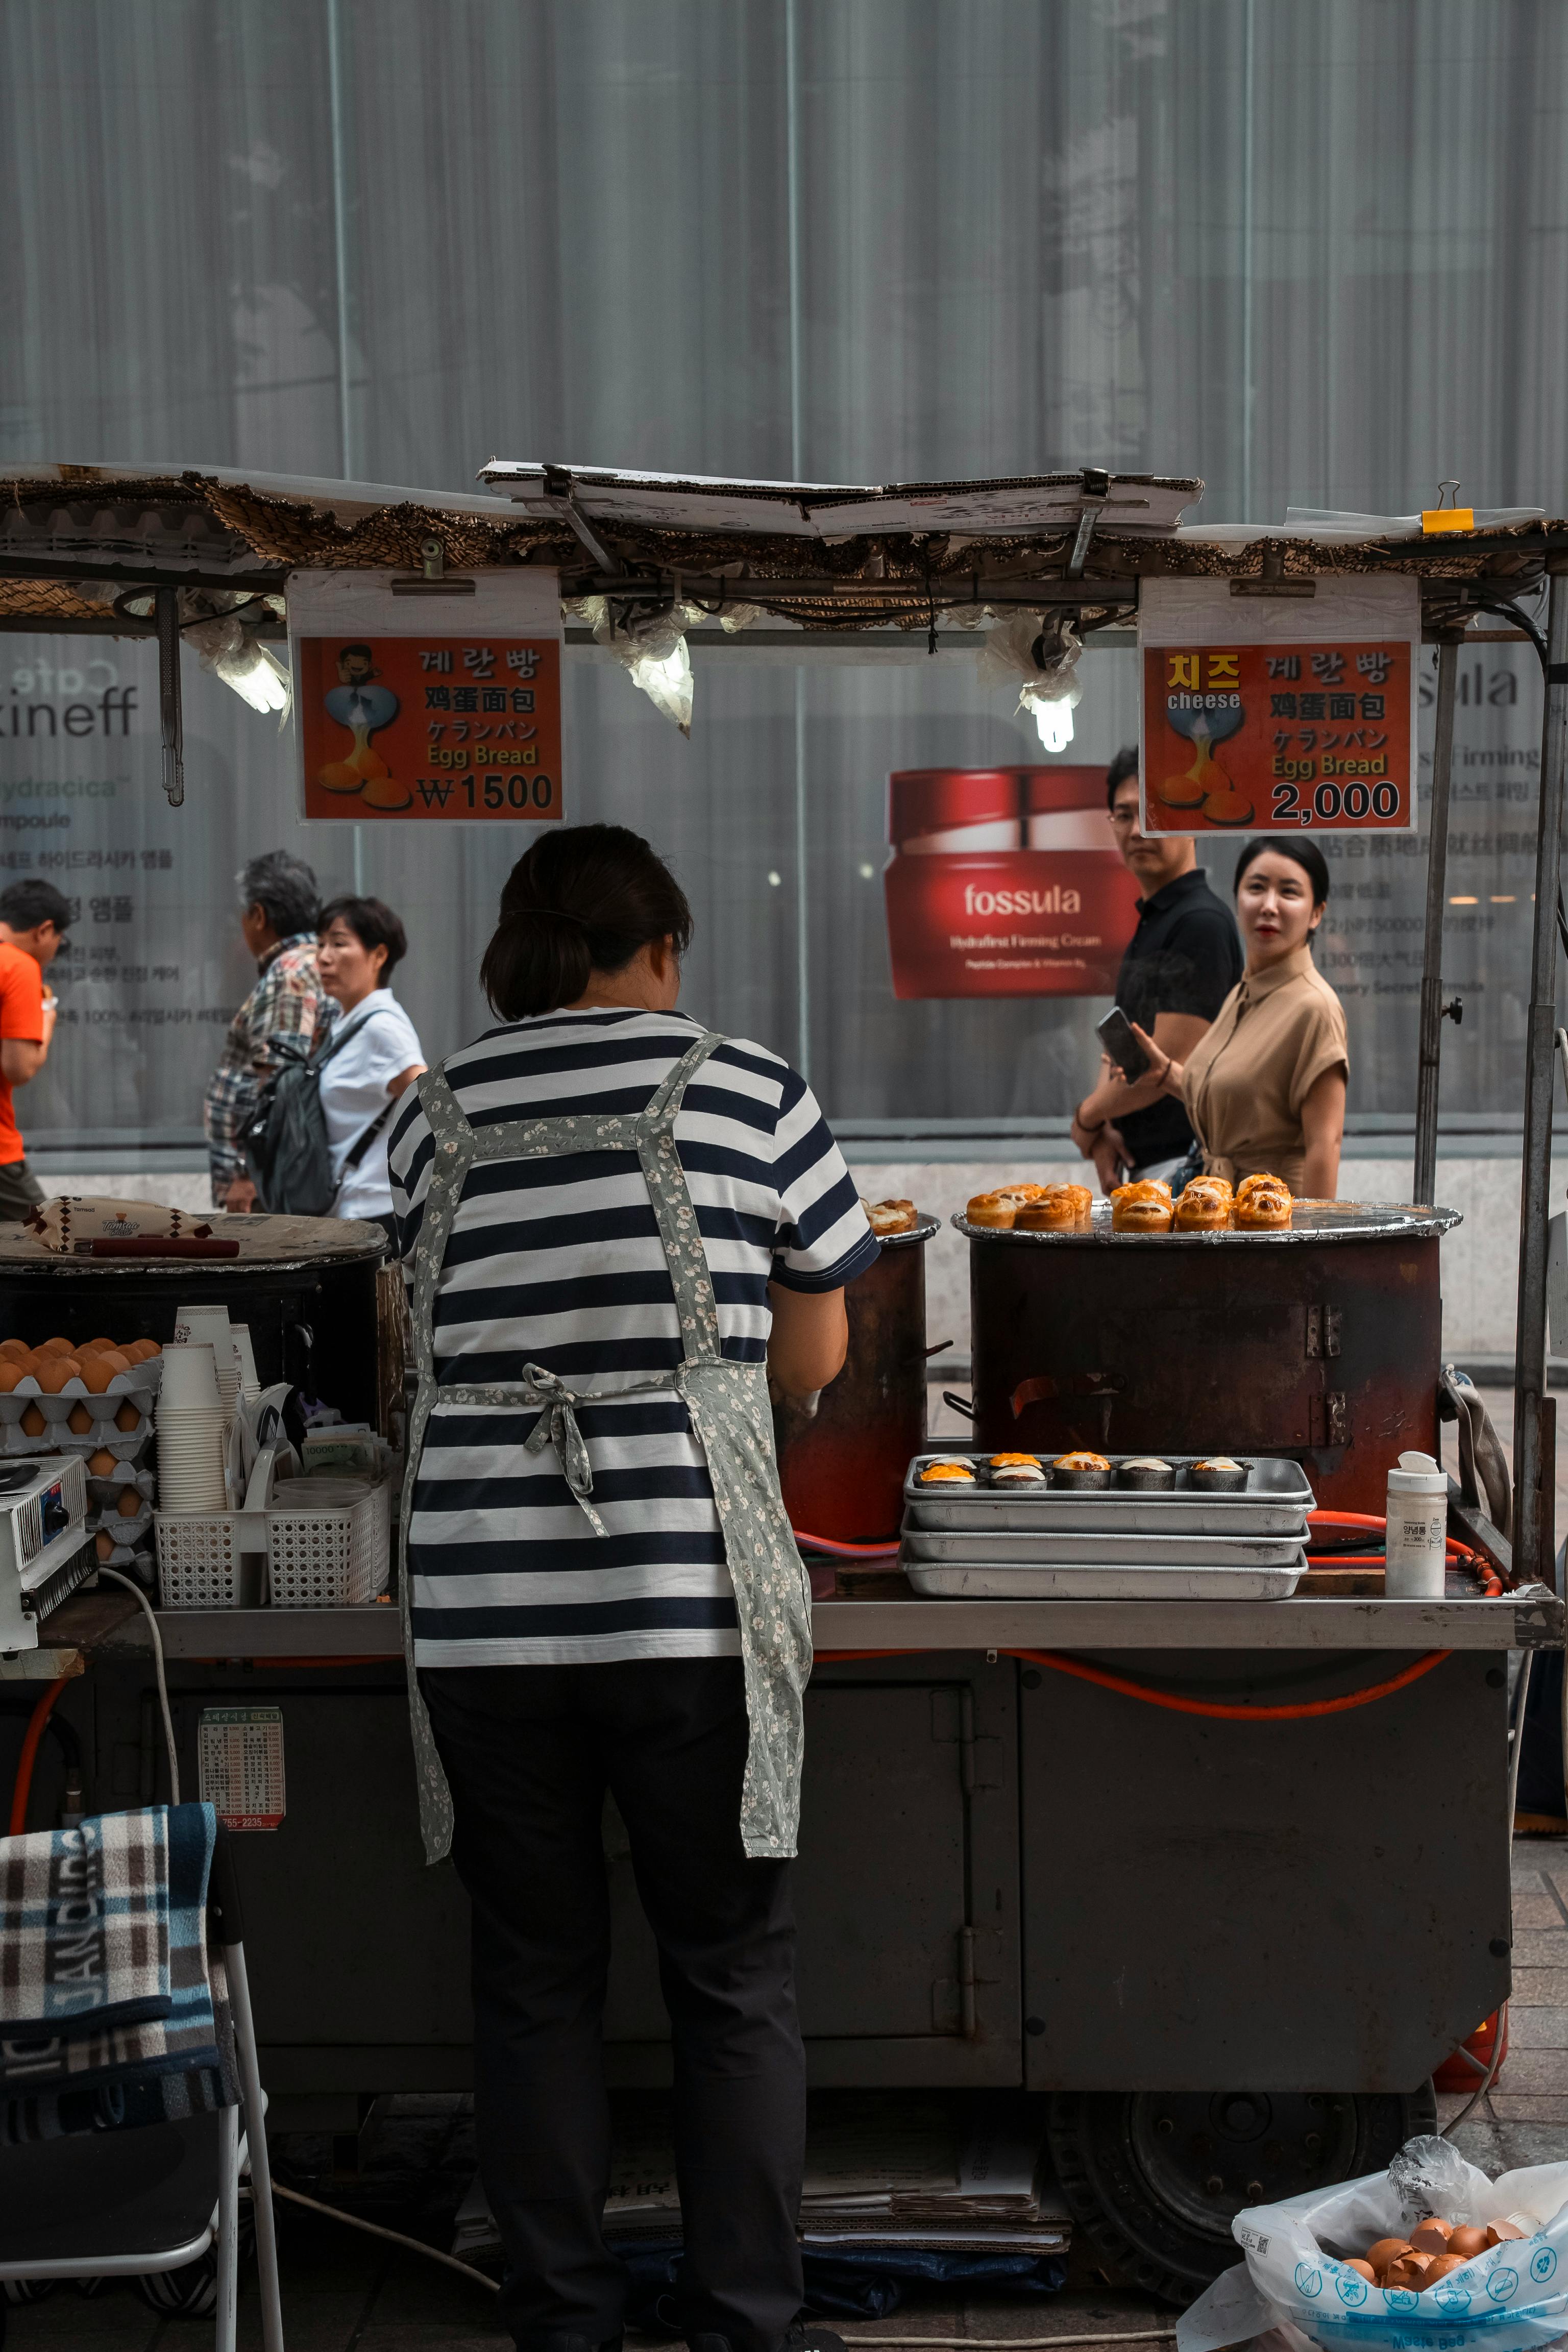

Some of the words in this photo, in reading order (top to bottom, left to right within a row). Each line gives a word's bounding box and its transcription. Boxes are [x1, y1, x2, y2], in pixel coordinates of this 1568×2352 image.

[1167, 654, 1241, 691] 치즈
[0, 686, 138, 737] ineff
[424, 686, 536, 714] 鸡蛋面包
[1167, 692, 1241, 709] cheese
[1270, 692, 1385, 721] 鸡蛋面包
[427, 719, 537, 741] ケランパン
[1272, 728, 1387, 750] ケランパン
[428, 744, 467, 768] Egg
[475, 744, 536, 765] Bread
[1271, 755, 1313, 779] Egg
[1320, 753, 1385, 774] Bread
[1271, 781, 1400, 826] 2,000
[964, 883, 1081, 915] fossula
[306, 1446, 334, 1455] 10000
[1403, 1526, 1427, 1535] 양념통
